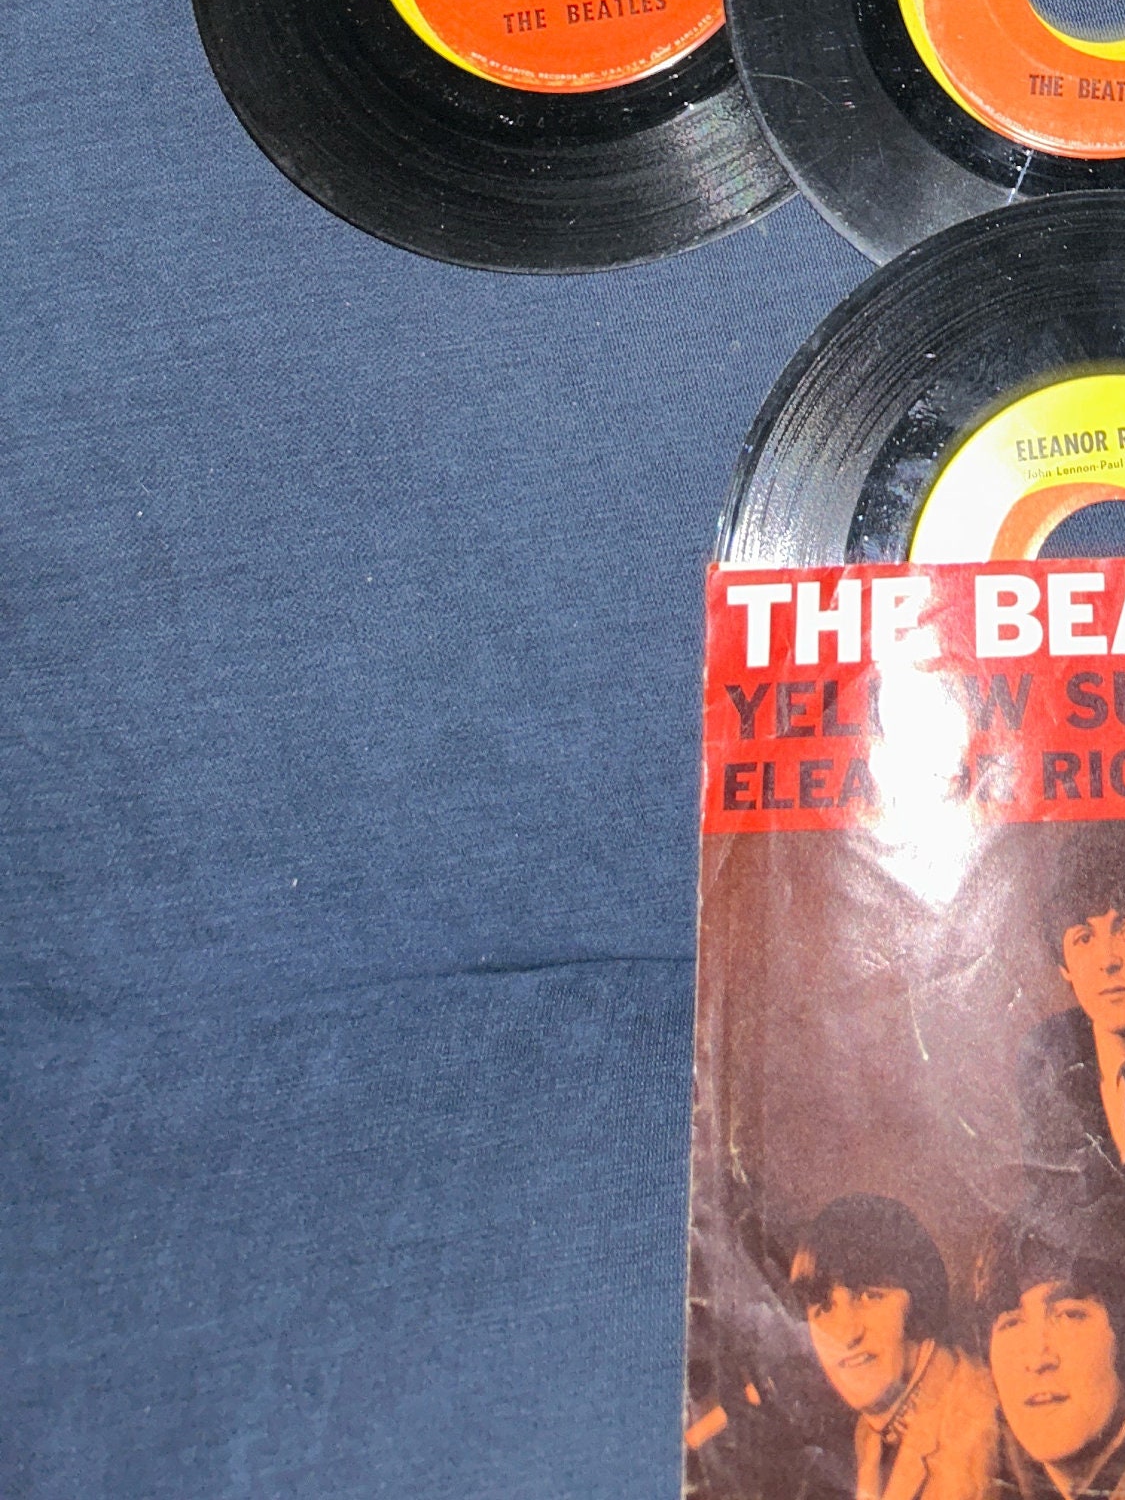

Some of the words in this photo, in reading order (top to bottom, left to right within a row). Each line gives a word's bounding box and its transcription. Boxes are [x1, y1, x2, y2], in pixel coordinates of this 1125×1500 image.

[503, 9, 547, 34] THE
[1029, 74, 1063, 97] THE
[1015, 430, 1109, 461] ELEANOR
[1024, 468, 1052, 481] John
[1056, 458, 1124, 477] Lennon-Paul
[726, 575, 937, 668] THE
[724, 673, 1034, 740] YELW
[723, 754, 1017, 811] ELEAR
